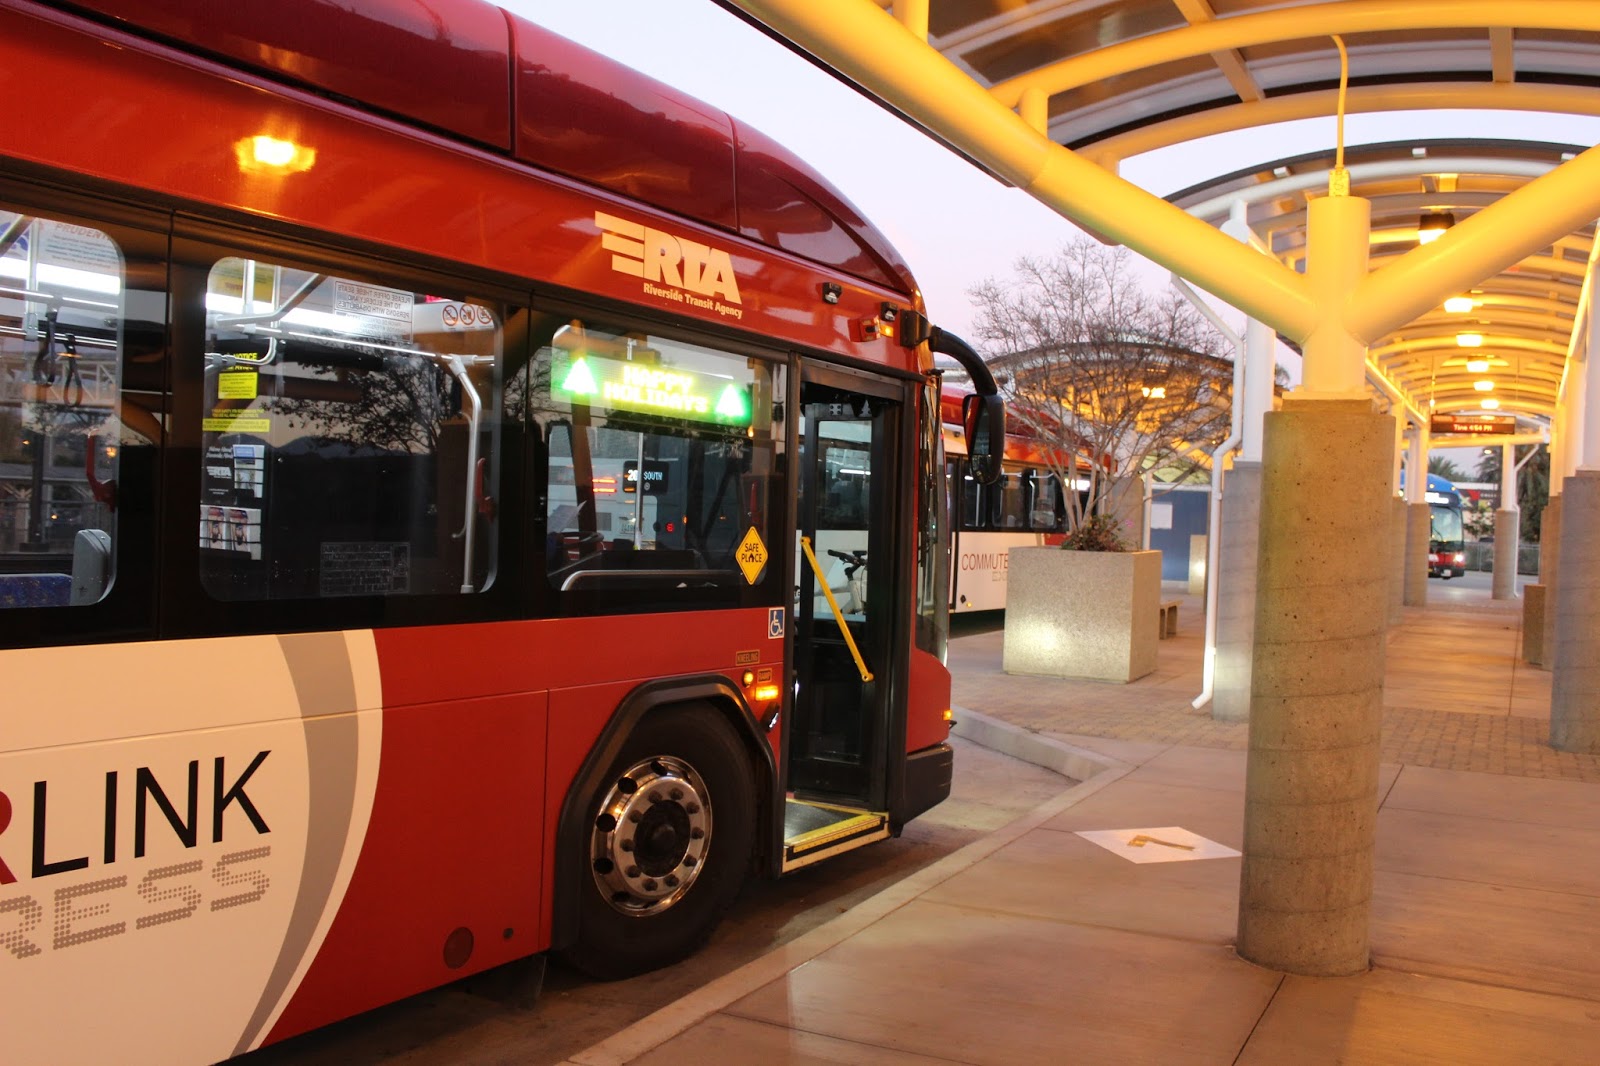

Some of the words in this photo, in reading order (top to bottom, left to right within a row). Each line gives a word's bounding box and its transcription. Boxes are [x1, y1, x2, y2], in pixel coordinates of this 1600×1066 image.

[643, 226, 742, 304] RTA
[643, 282, 683, 303] Riverside
[684, 294, 713, 311] Transit
[714, 302, 743, 320] Agency
[623, 365, 693, 394] HAPPY
[604, 381, 708, 412] HOLIDAYS
[643, 471, 663, 480] SOUTH
[741, 552, 763, 563] PLACE
[744, 542, 759, 553] SAFE
[962, 553, 1009, 571] COMMUTE
